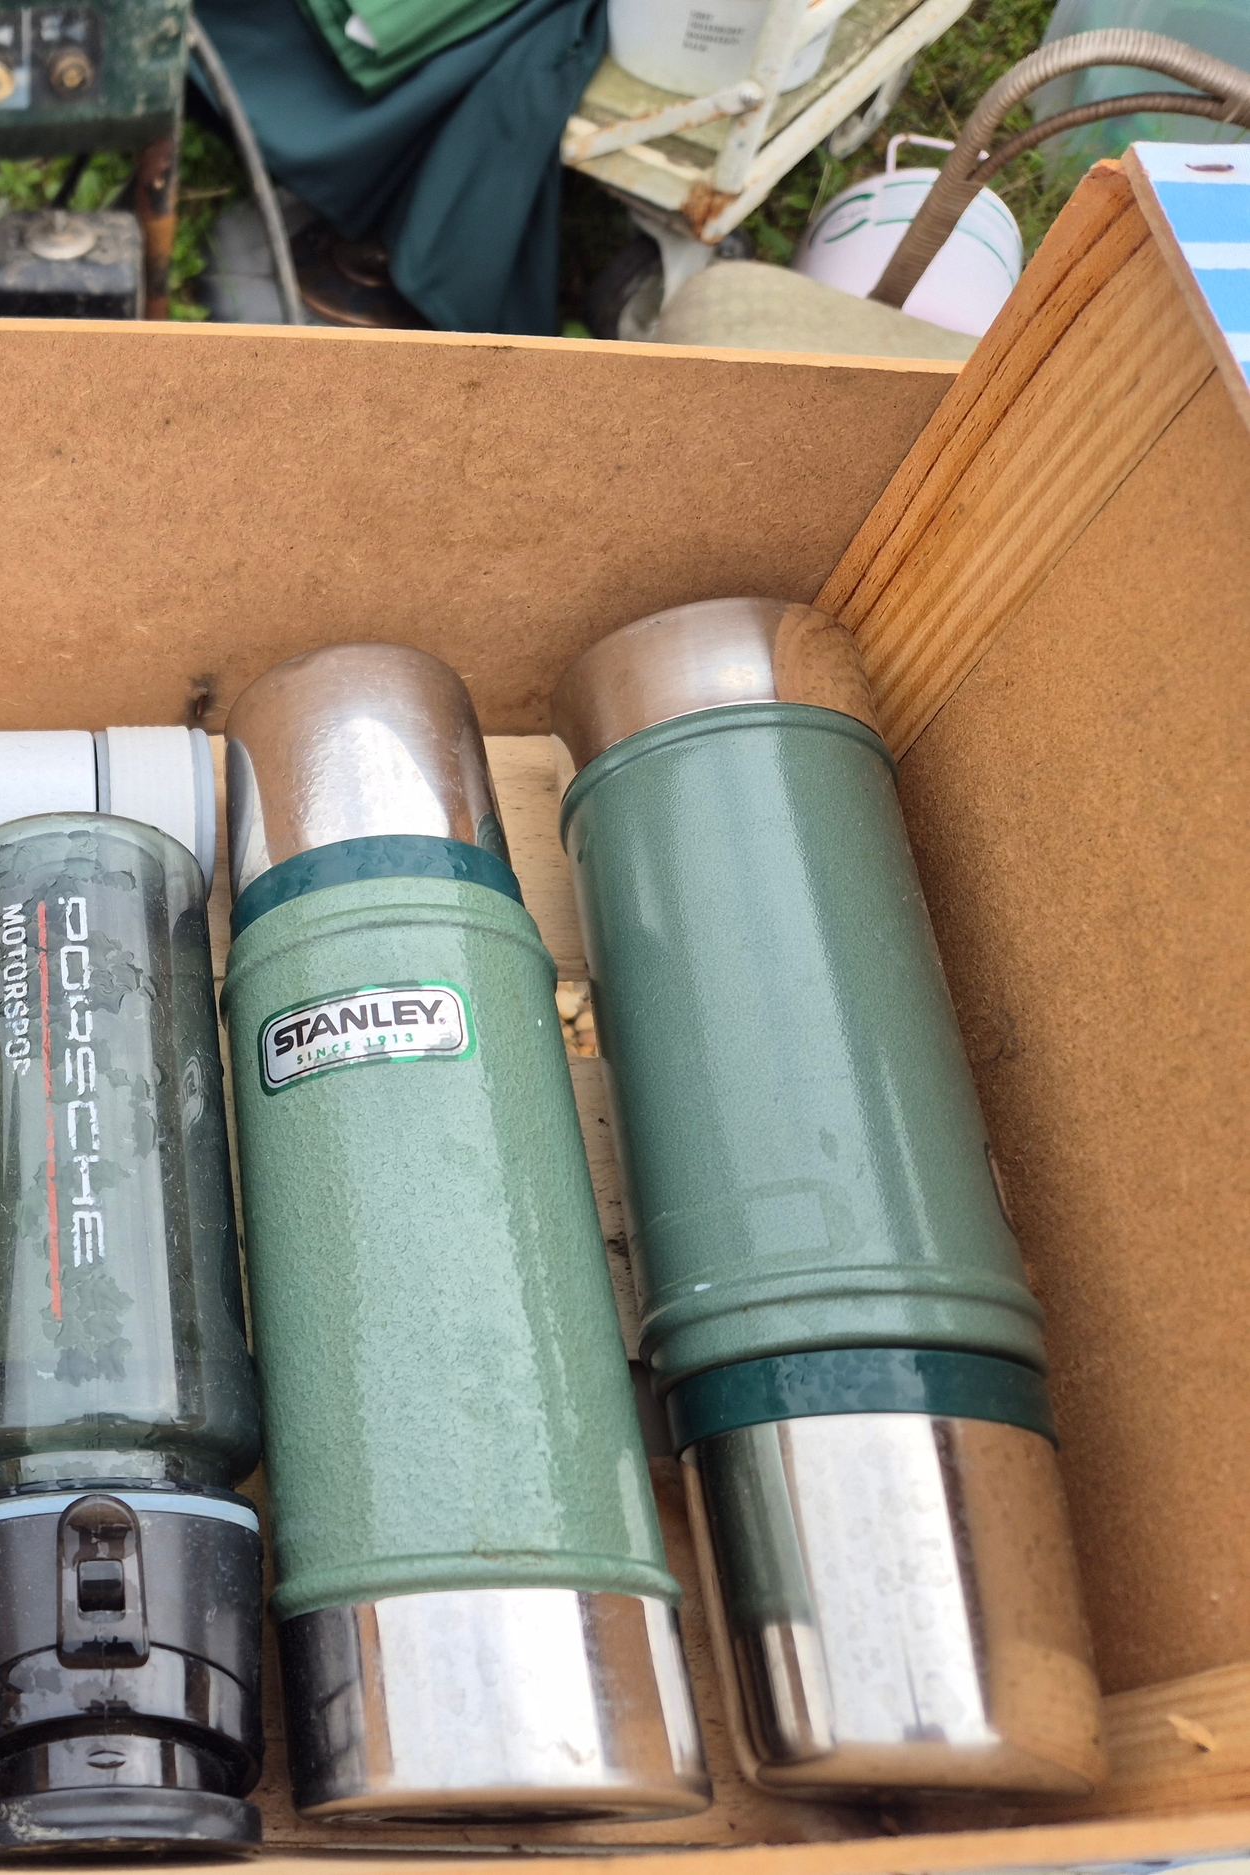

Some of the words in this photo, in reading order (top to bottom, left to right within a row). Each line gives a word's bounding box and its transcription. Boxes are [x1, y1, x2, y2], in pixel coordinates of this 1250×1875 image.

[273, 999, 444, 1057] STANLEY
[296, 1042, 351, 1065] SINCE
[365, 1032, 414, 1047] 1913
[58, 897, 106, 1267] PORSCHE
